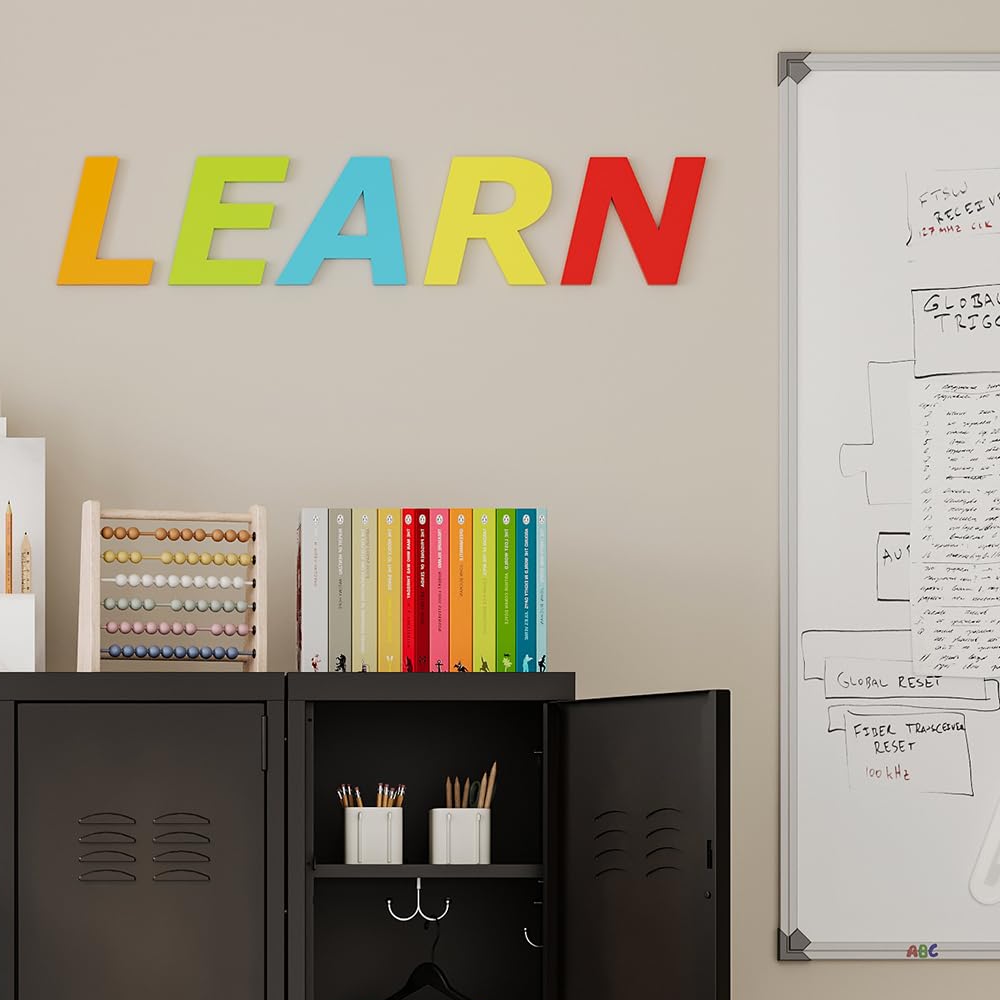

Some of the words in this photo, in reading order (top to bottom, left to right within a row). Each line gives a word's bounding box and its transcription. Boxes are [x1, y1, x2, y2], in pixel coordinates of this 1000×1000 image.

[57, 156, 707, 286] LEARN
[837, 672, 888, 689] GLOBAL
[898, 675, 943, 688] RESET
[874, 741, 917, 753] RESET
[906, 943, 939, 958] ABC
